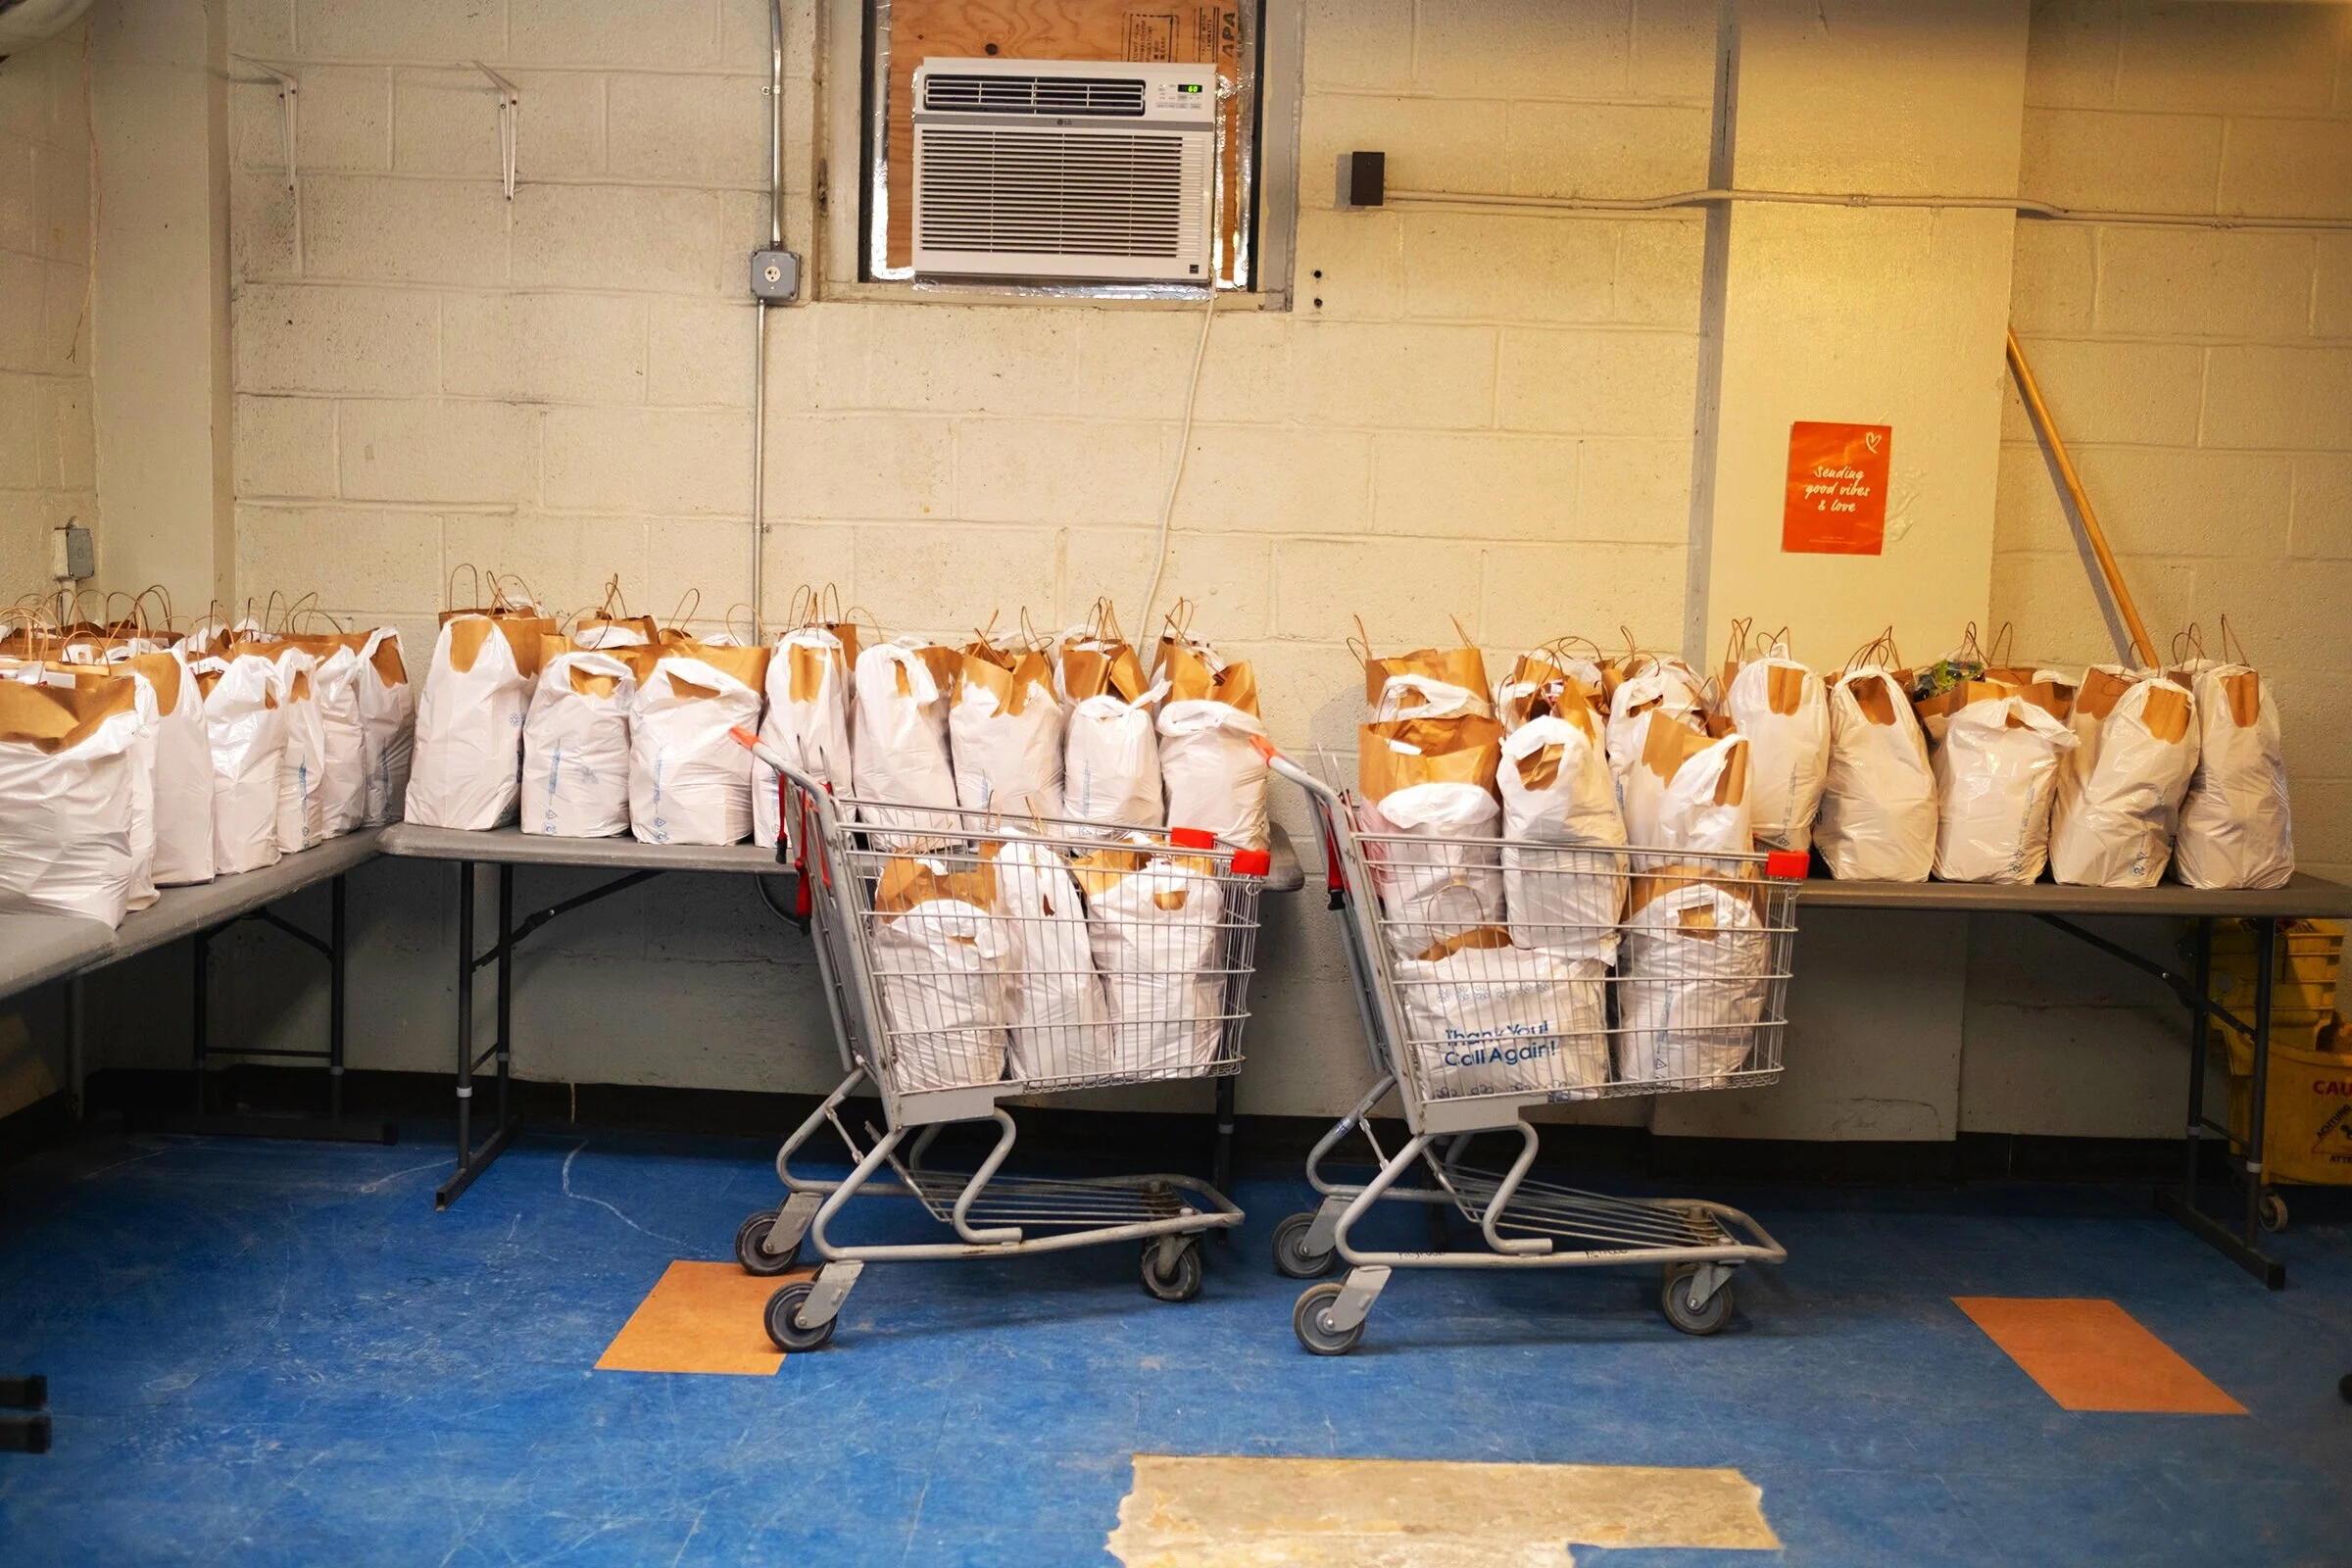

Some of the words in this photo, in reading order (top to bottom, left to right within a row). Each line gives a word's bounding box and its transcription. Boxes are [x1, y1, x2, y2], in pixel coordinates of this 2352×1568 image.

[1221, 13, 1236, 58] APA
[1814, 466, 1865, 486] Sending
[1804, 481, 1838, 500] good
[1839, 479, 1871, 497] vibes
[1818, 500, 1826, 512] &
[1831, 499, 1856, 513] love
[1446, 1028, 1504, 1047] Thank
[1445, 1049, 1486, 1066] Call
[1489, 1040, 1556, 1066] Again!
